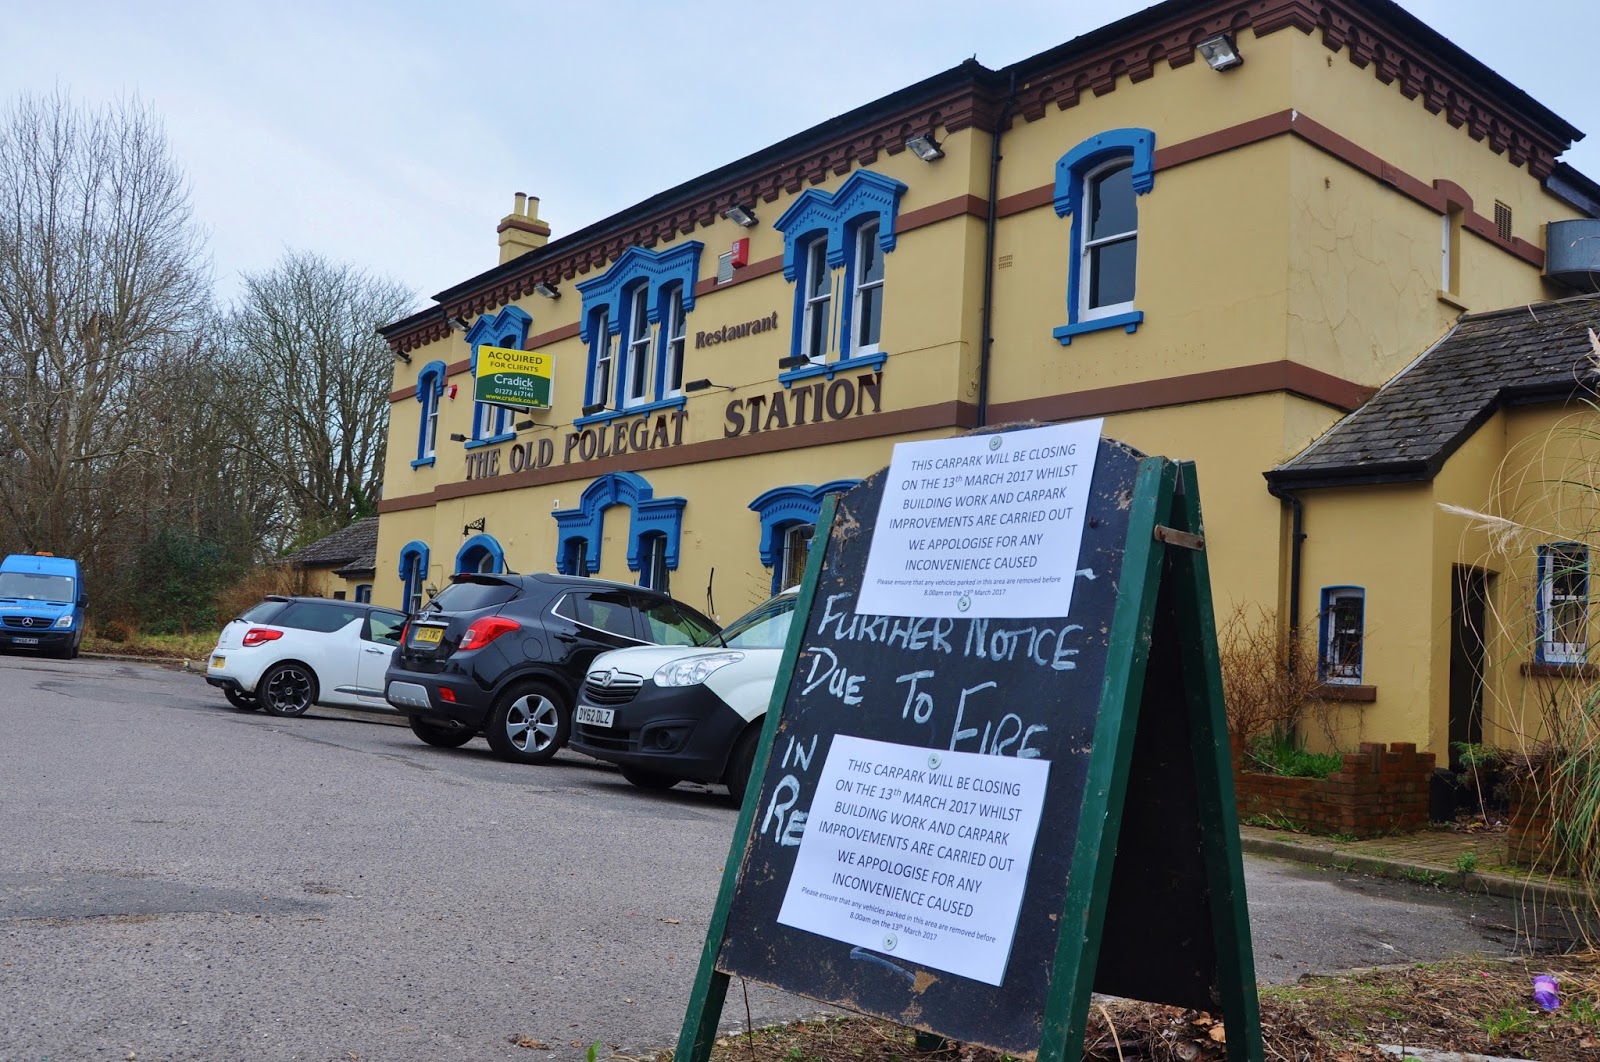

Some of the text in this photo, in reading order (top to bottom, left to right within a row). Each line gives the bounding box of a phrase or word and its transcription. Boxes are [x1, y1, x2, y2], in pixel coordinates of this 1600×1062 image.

[695, 311, 778, 349] Restaurant
[488, 351, 542, 364] ACQUIRED
[508, 364, 538, 372] CLIENTS
[494, 374, 533, 387] Cradick
[514, 390, 533, 398] 617141
[486, 394, 539, 404] www.cradick.co.uk
[465, 372, 883, 480] THE OLD POLEGAT STATION
[912, 444, 1076, 471] THIS CARPARK WILL BE CLOSING
[902, 464, 1078, 490] ON THE 13th MARCH 2017 WHILST
[903, 487, 1067, 509] BUILDING WORK AND CARPARK
[889, 507, 1073, 529] IMPROVEMENTS ARE CARRIED OUT
[909, 533, 1043, 550] WE APPOLOGISE FOR ANY
[905, 556, 1037, 570] INCONVENIENCE CAUSED
[957, 578, 975, 586] parked
[1016, 576, 1040, 584] removed
[579, 708, 610, 724] DY62 DLZ
[802, 647, 1048, 758] DUE TO FIRE
[782, 734, 818, 771] IN
[848, 759, 1021, 796] THIS CARPARK WILL BE CLOSING
[835, 779, 1022, 822] ON THE 13th MARCH 2017 WHILST
[834, 801, 1010, 846] BUILDING WORK AND CARPARK
[819, 821, 1014, 872] IMPROVEMENTS ARE CARRIED OUT
[837, 850, 982, 893] WE APPOLOGISE FOR ANY
[832, 872, 973, 917] INCONVENIENCE CAUSED
[801, 887, 819, 897] Please
[819, 892, 838, 902] ensure
[839, 897, 851, 906] that
[851, 901, 862, 909] any
[863, 904, 885, 914] vehicles
[886, 910, 905, 920] parked
[913, 916, 924, 924] this
[924, 920, 938, 928] area
[949, 926, 976, 938] removed
[976, 932, 996, 943] before
[850, 912, 871, 923] 8.00am
[881, 920, 890, 928] the
[904, 926, 921, 937] March
[922, 931, 937, 940] 2017
